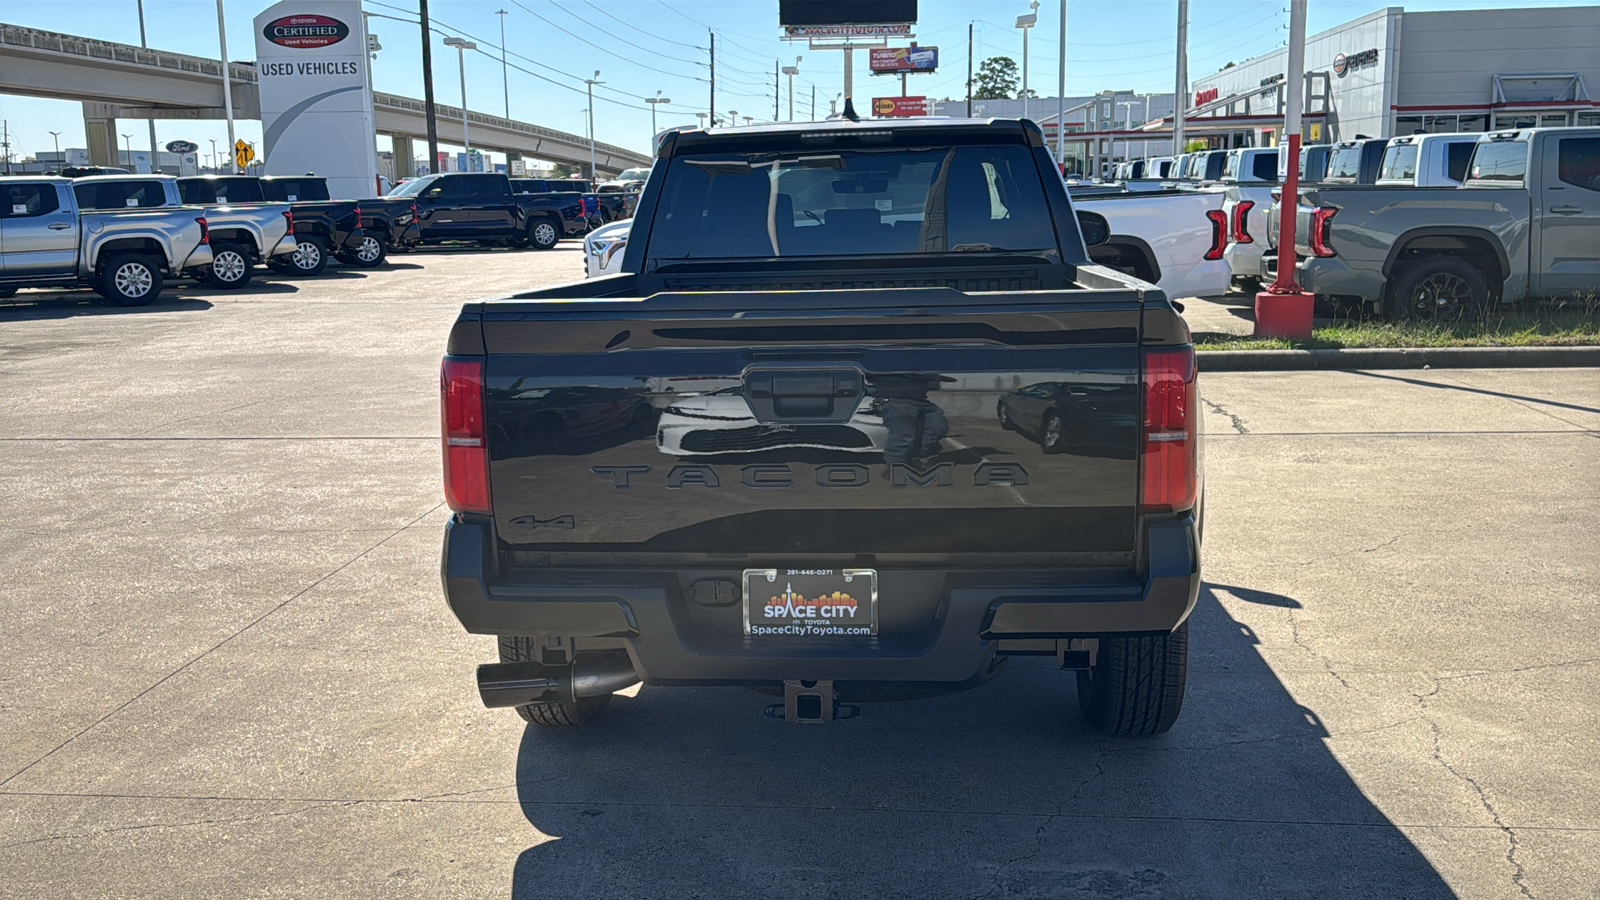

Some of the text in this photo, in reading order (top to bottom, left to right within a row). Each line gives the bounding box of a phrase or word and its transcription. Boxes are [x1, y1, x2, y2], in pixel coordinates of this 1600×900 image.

[274, 26, 338, 36] CERTIFIED
[262, 62, 357, 76] USED VEHICLES
[172, 142, 190, 152] Ford
[590, 462, 1030, 489] TACOMA
[764, 605, 858, 618] SPACE CITY
[752, 626, 870, 636] SpaceCityToyota.com
